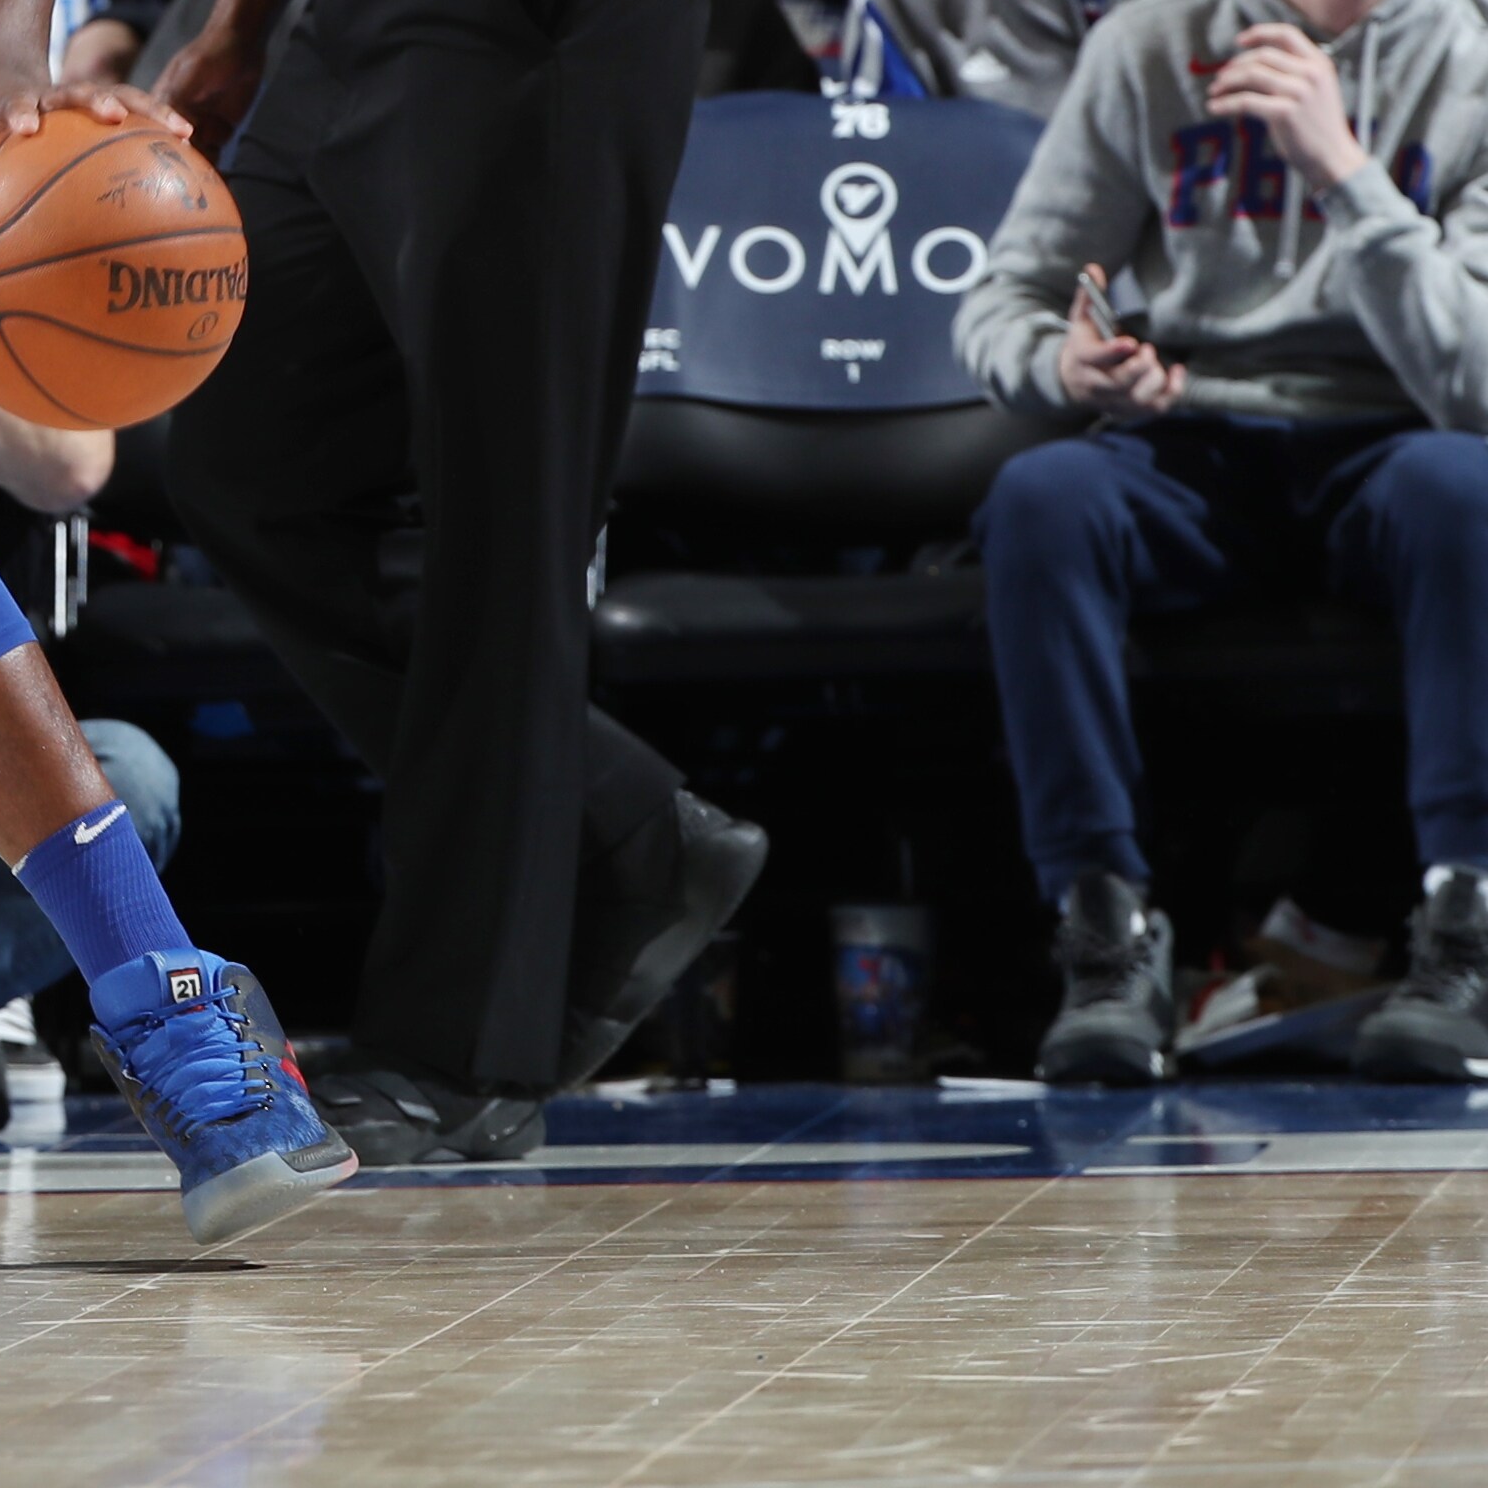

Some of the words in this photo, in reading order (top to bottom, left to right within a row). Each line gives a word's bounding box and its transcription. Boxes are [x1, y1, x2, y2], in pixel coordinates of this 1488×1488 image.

[107, 257, 248, 313] PALDING
[820, 338, 886, 361] ROW
[176, 978, 198, 999] 21
